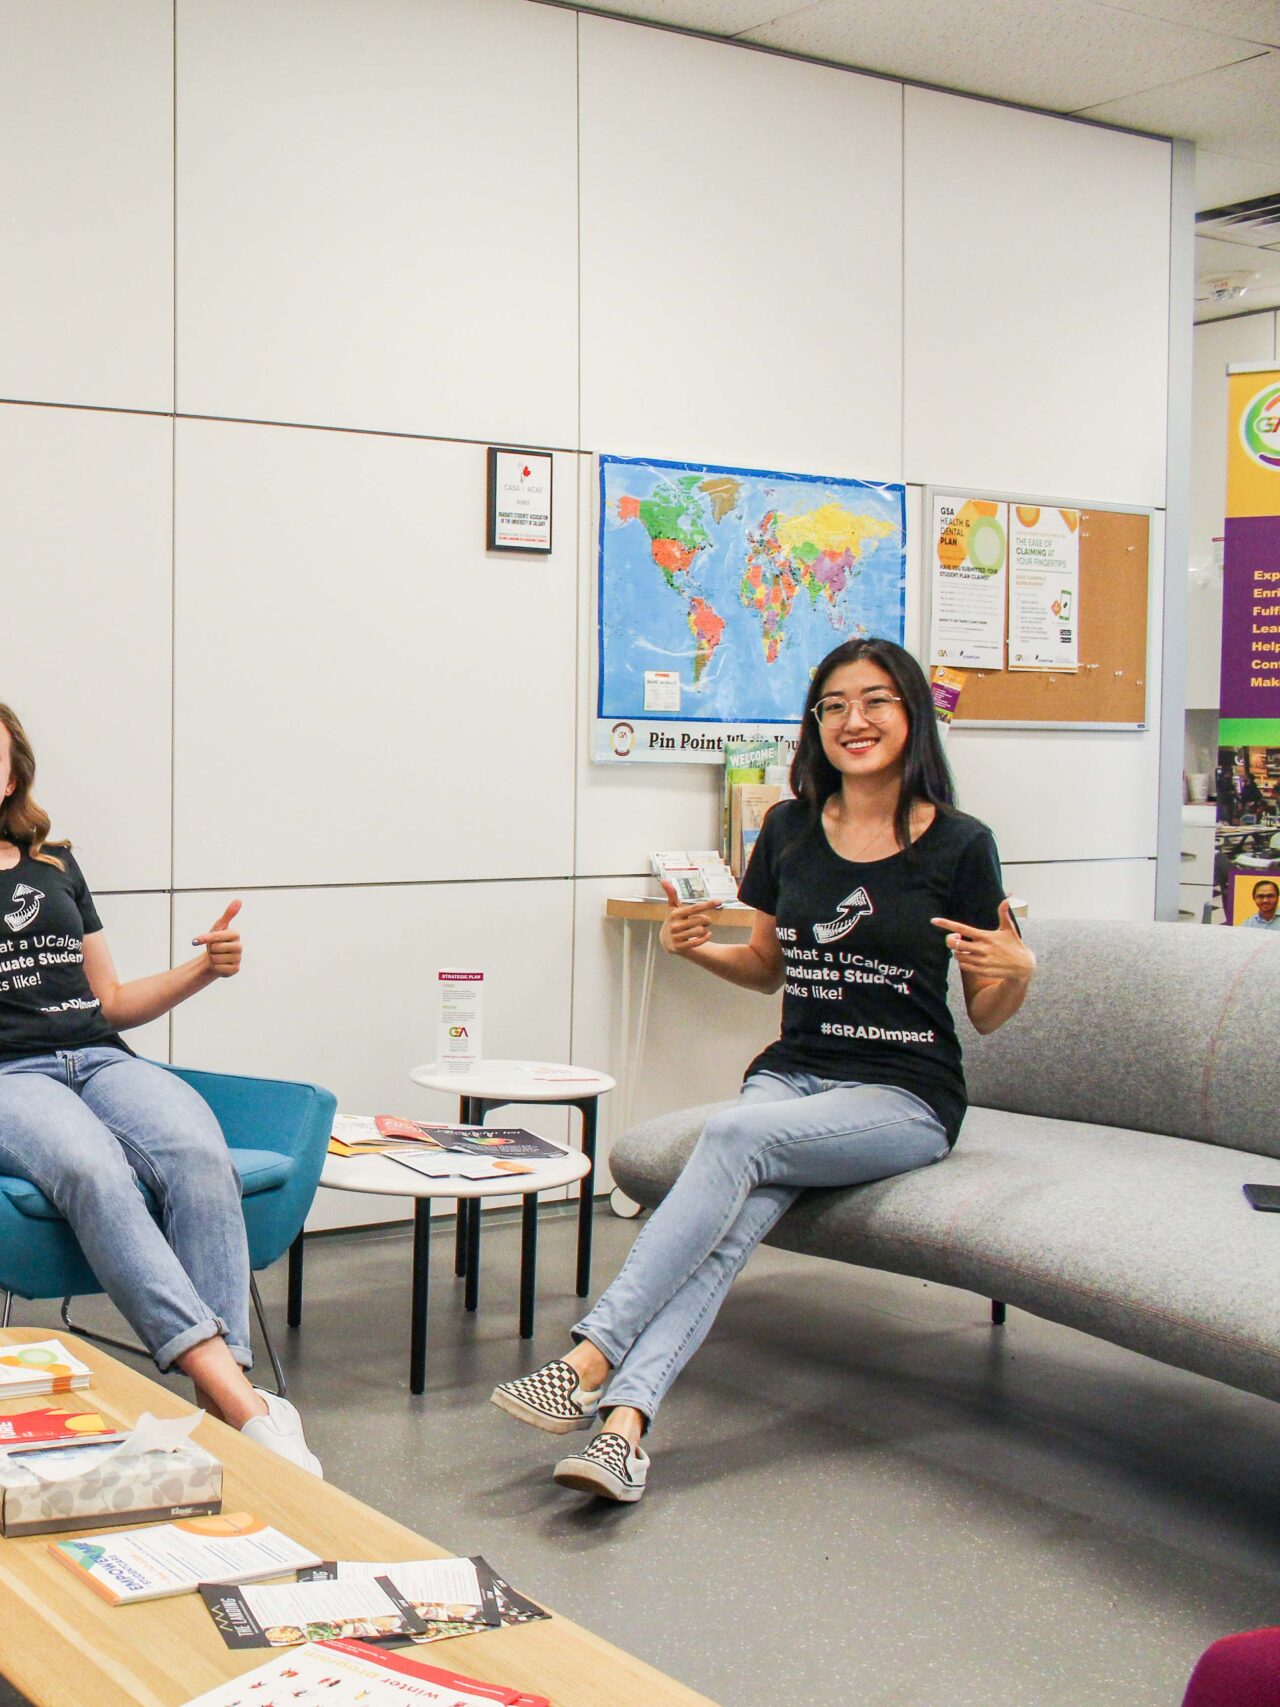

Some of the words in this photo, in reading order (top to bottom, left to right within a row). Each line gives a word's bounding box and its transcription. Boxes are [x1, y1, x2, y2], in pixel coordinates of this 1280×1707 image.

[940, 507, 955, 515] GSA
[940, 517, 964, 527] HEALTH
[940, 526, 964, 537] DENTAL
[939, 536, 958, 546] PLAN
[1015, 547, 1047, 557] CLAIMING
[648, 731, 676, 749] Pin
[680, 733, 724, 750] Point
[730, 747, 775, 767] WELCOME
[19, 939, 29, 950] a
[787, 946, 820, 961] what
[824, 952, 834, 963] a
[839, 952, 915, 979] UCalgary
[13, 972, 42, 989] like!
[812, 985, 843, 1001] like!
[820, 1022, 935, 1044] #GRADImpact
[89, 1552, 145, 1592] EMPOWER
[381, 1677, 440, 1700] winter
